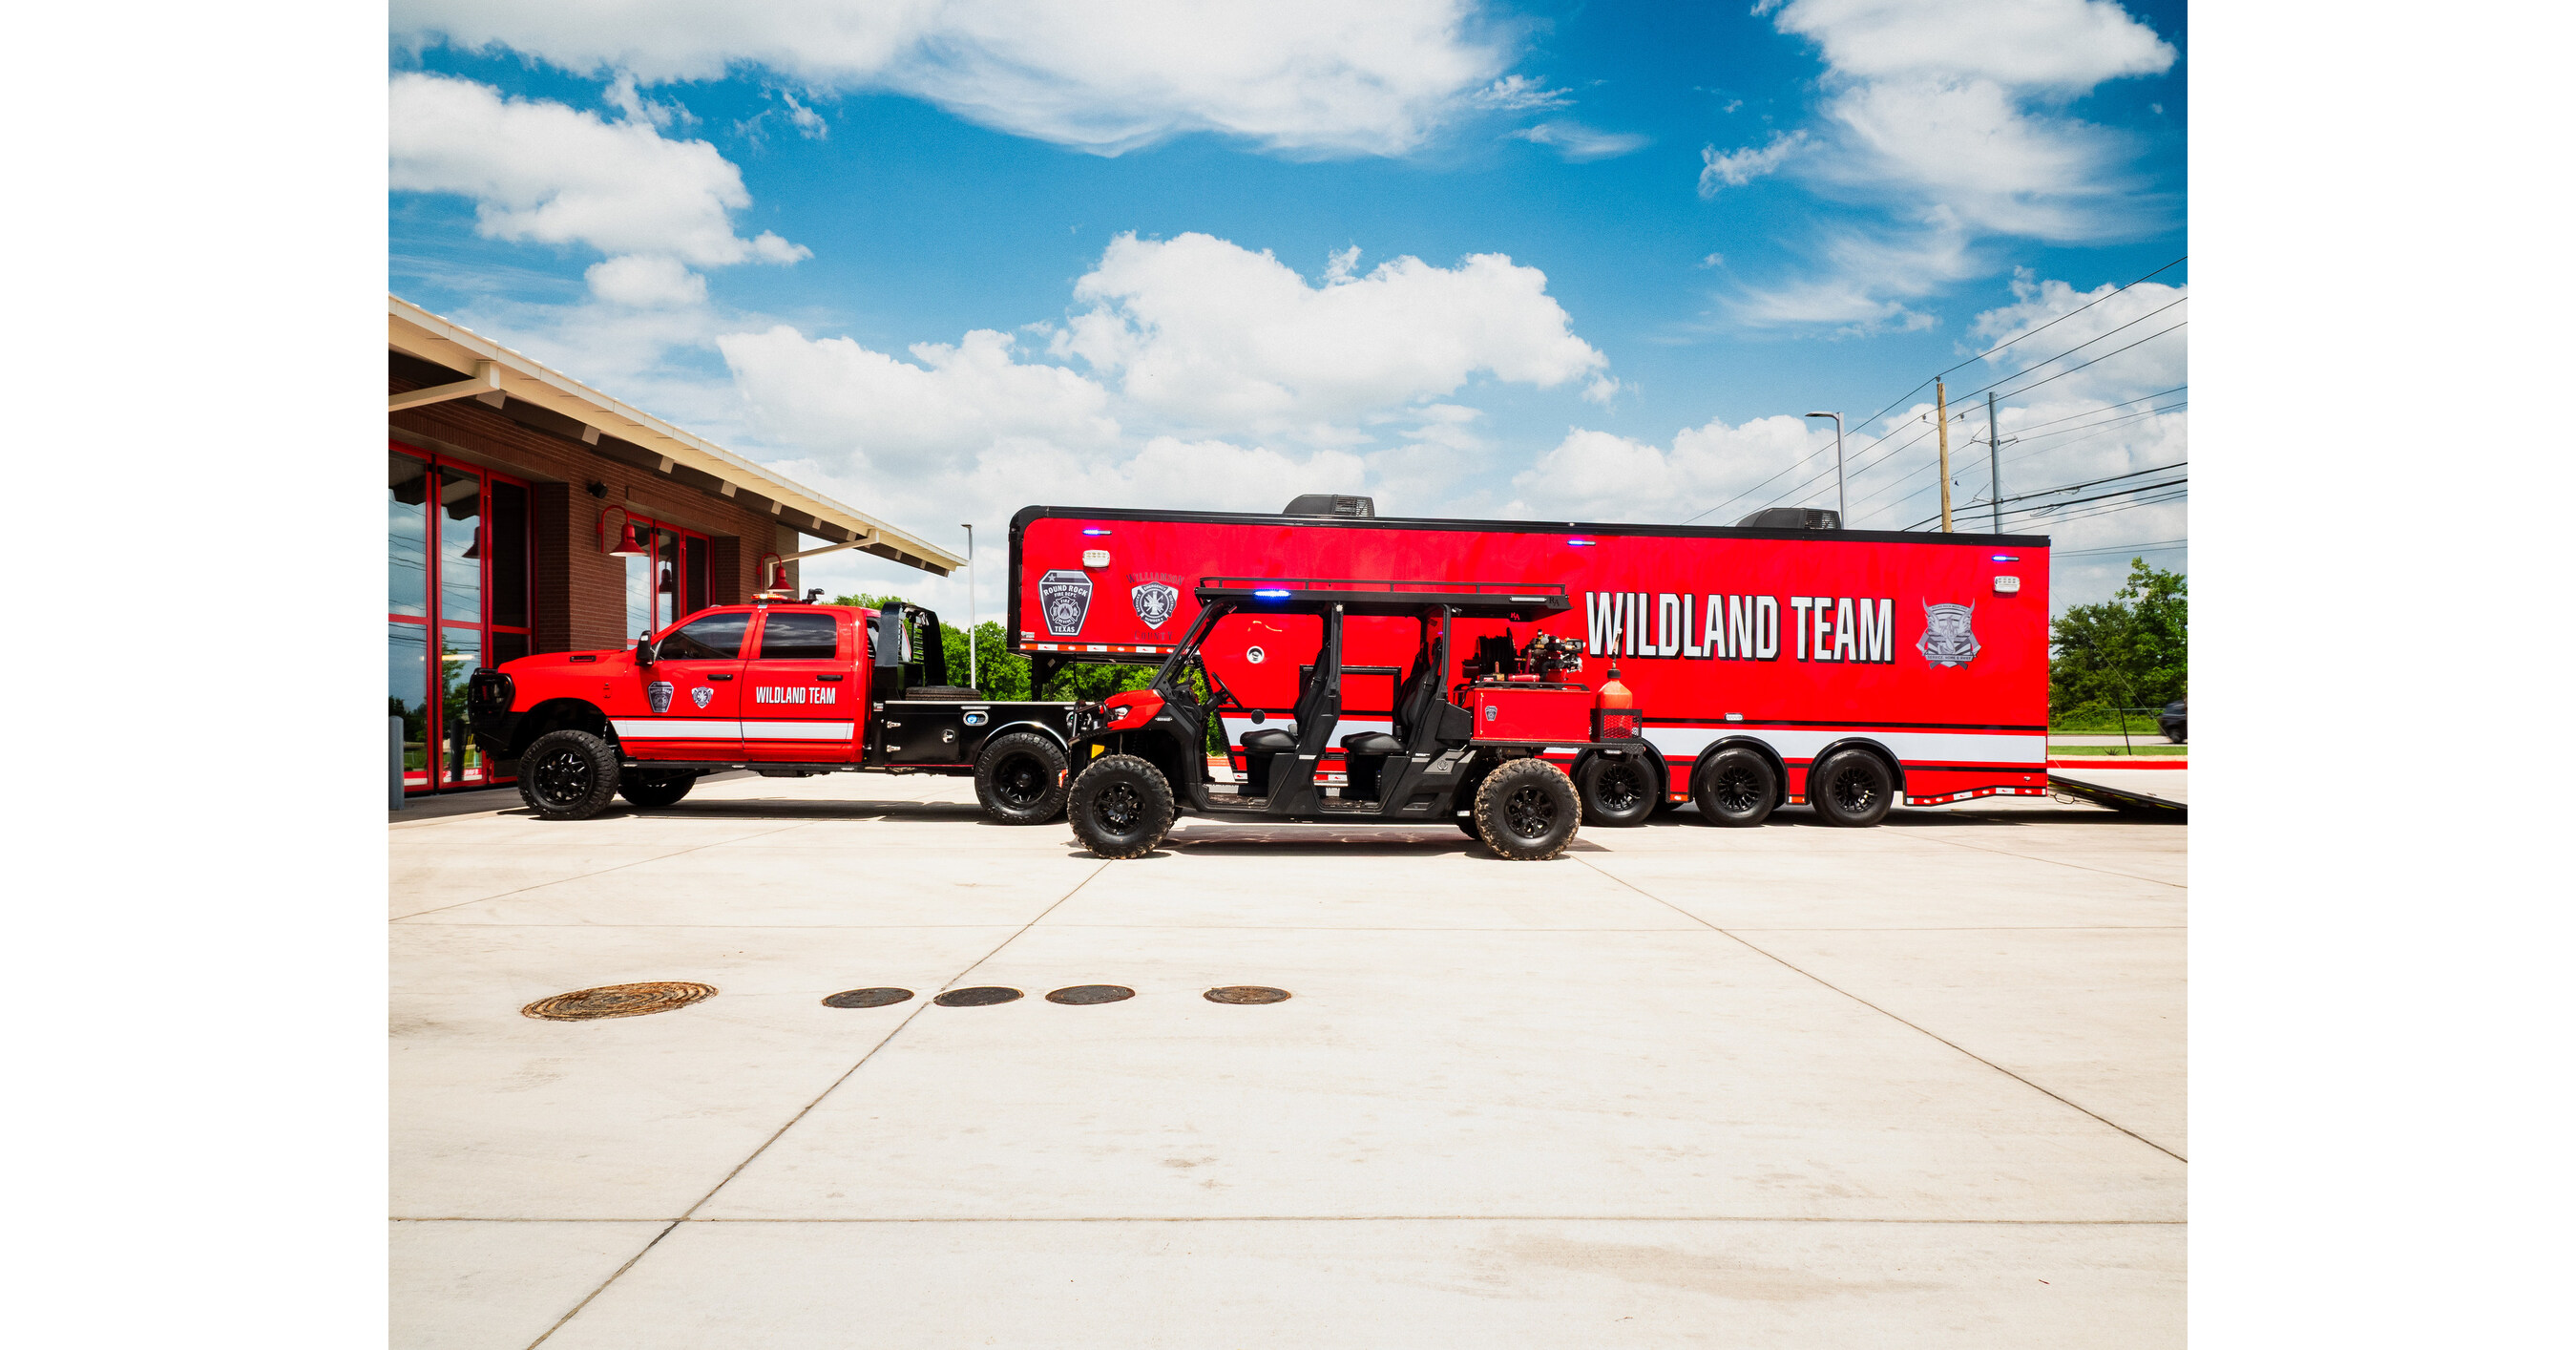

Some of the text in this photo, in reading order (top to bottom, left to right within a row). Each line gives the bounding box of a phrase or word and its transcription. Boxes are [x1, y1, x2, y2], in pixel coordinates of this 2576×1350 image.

[1126, 572, 1184, 585] WILLIAMSON
[1043, 584, 1088, 597] ROUND ROCK
[1585, 591, 1895, 664] WILDLAND TEAM
[1135, 630, 1173, 641] COUNTY
[756, 686, 836, 705] WILDLAND TEAM
